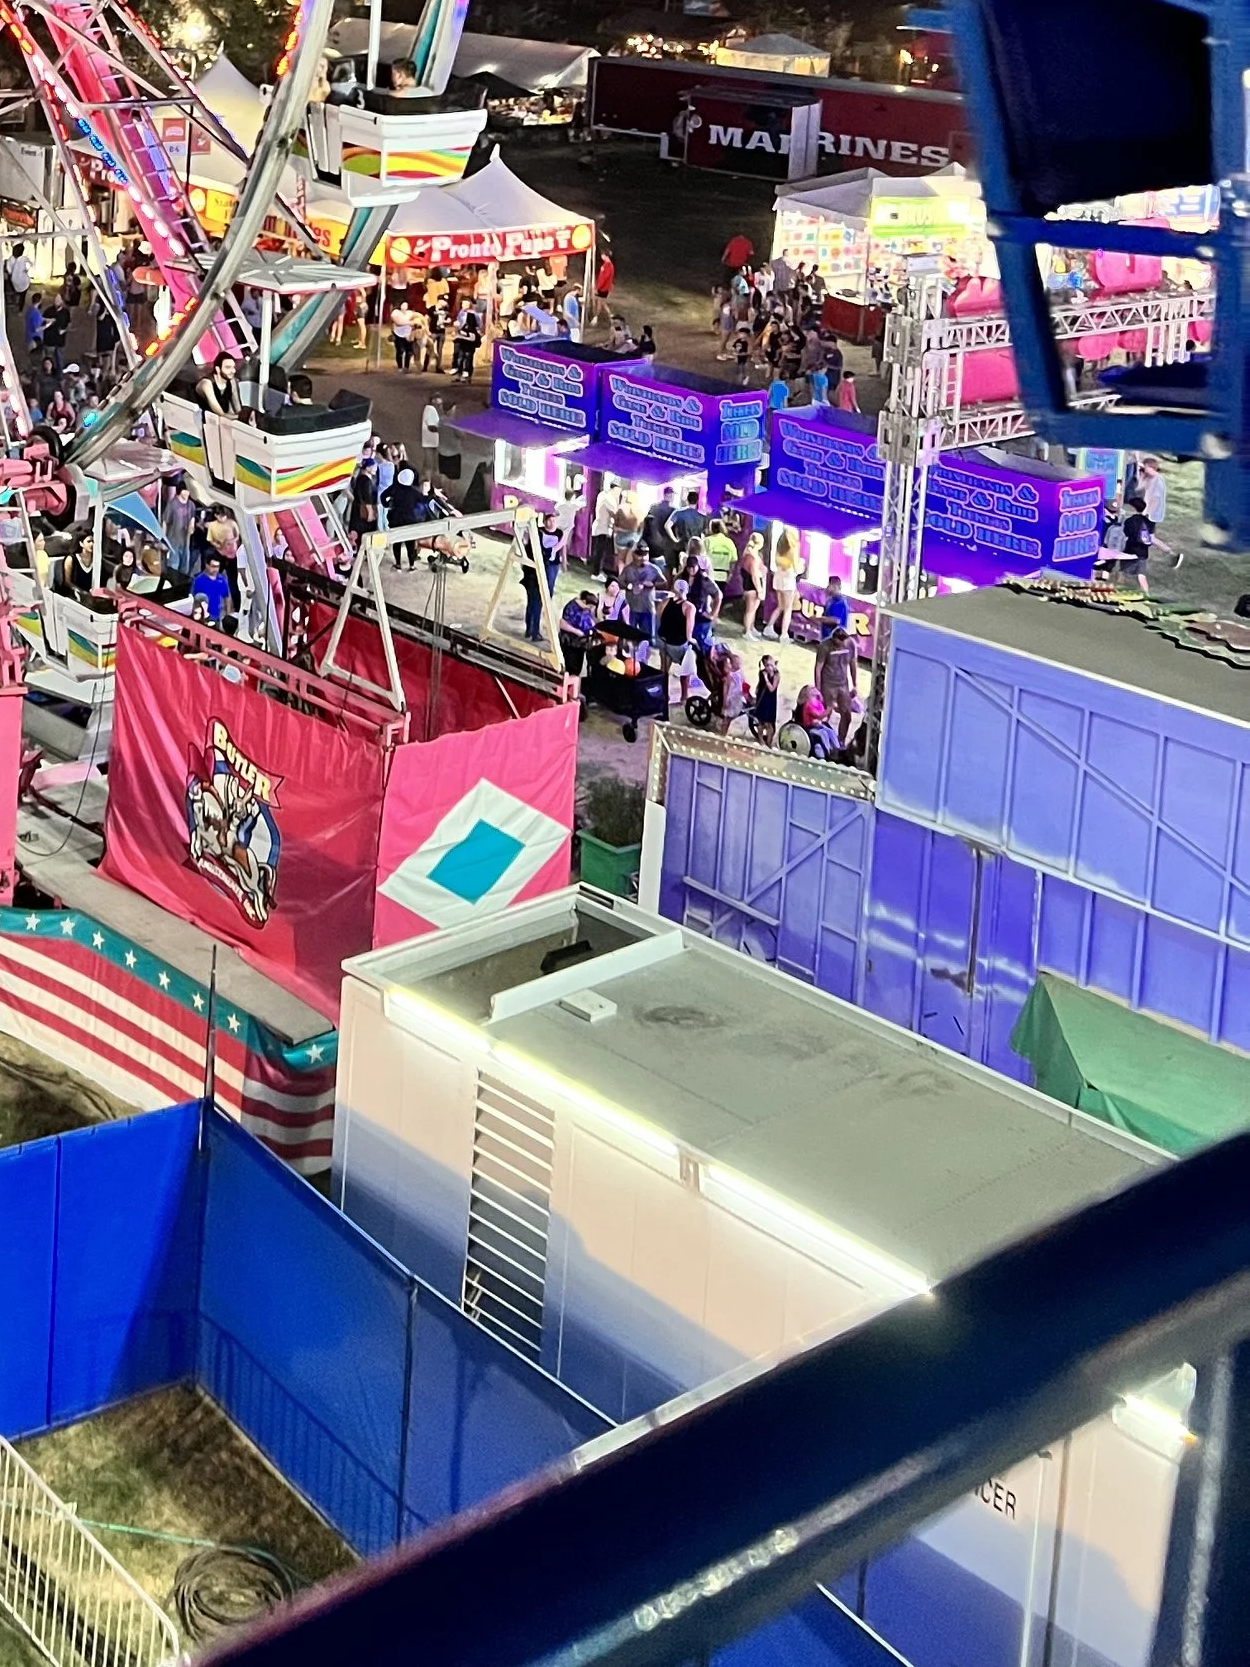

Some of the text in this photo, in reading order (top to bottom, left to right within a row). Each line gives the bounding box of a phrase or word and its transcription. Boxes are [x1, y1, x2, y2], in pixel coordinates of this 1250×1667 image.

[431, 236, 501, 262] Pronto
[504, 231, 554, 260] Pups
[651, 404, 666, 420] &
[686, 397, 702, 414] &
[971, 491, 993, 509] &
[1017, 484, 1039, 504] &
[213, 721, 272, 802] BUTLER
